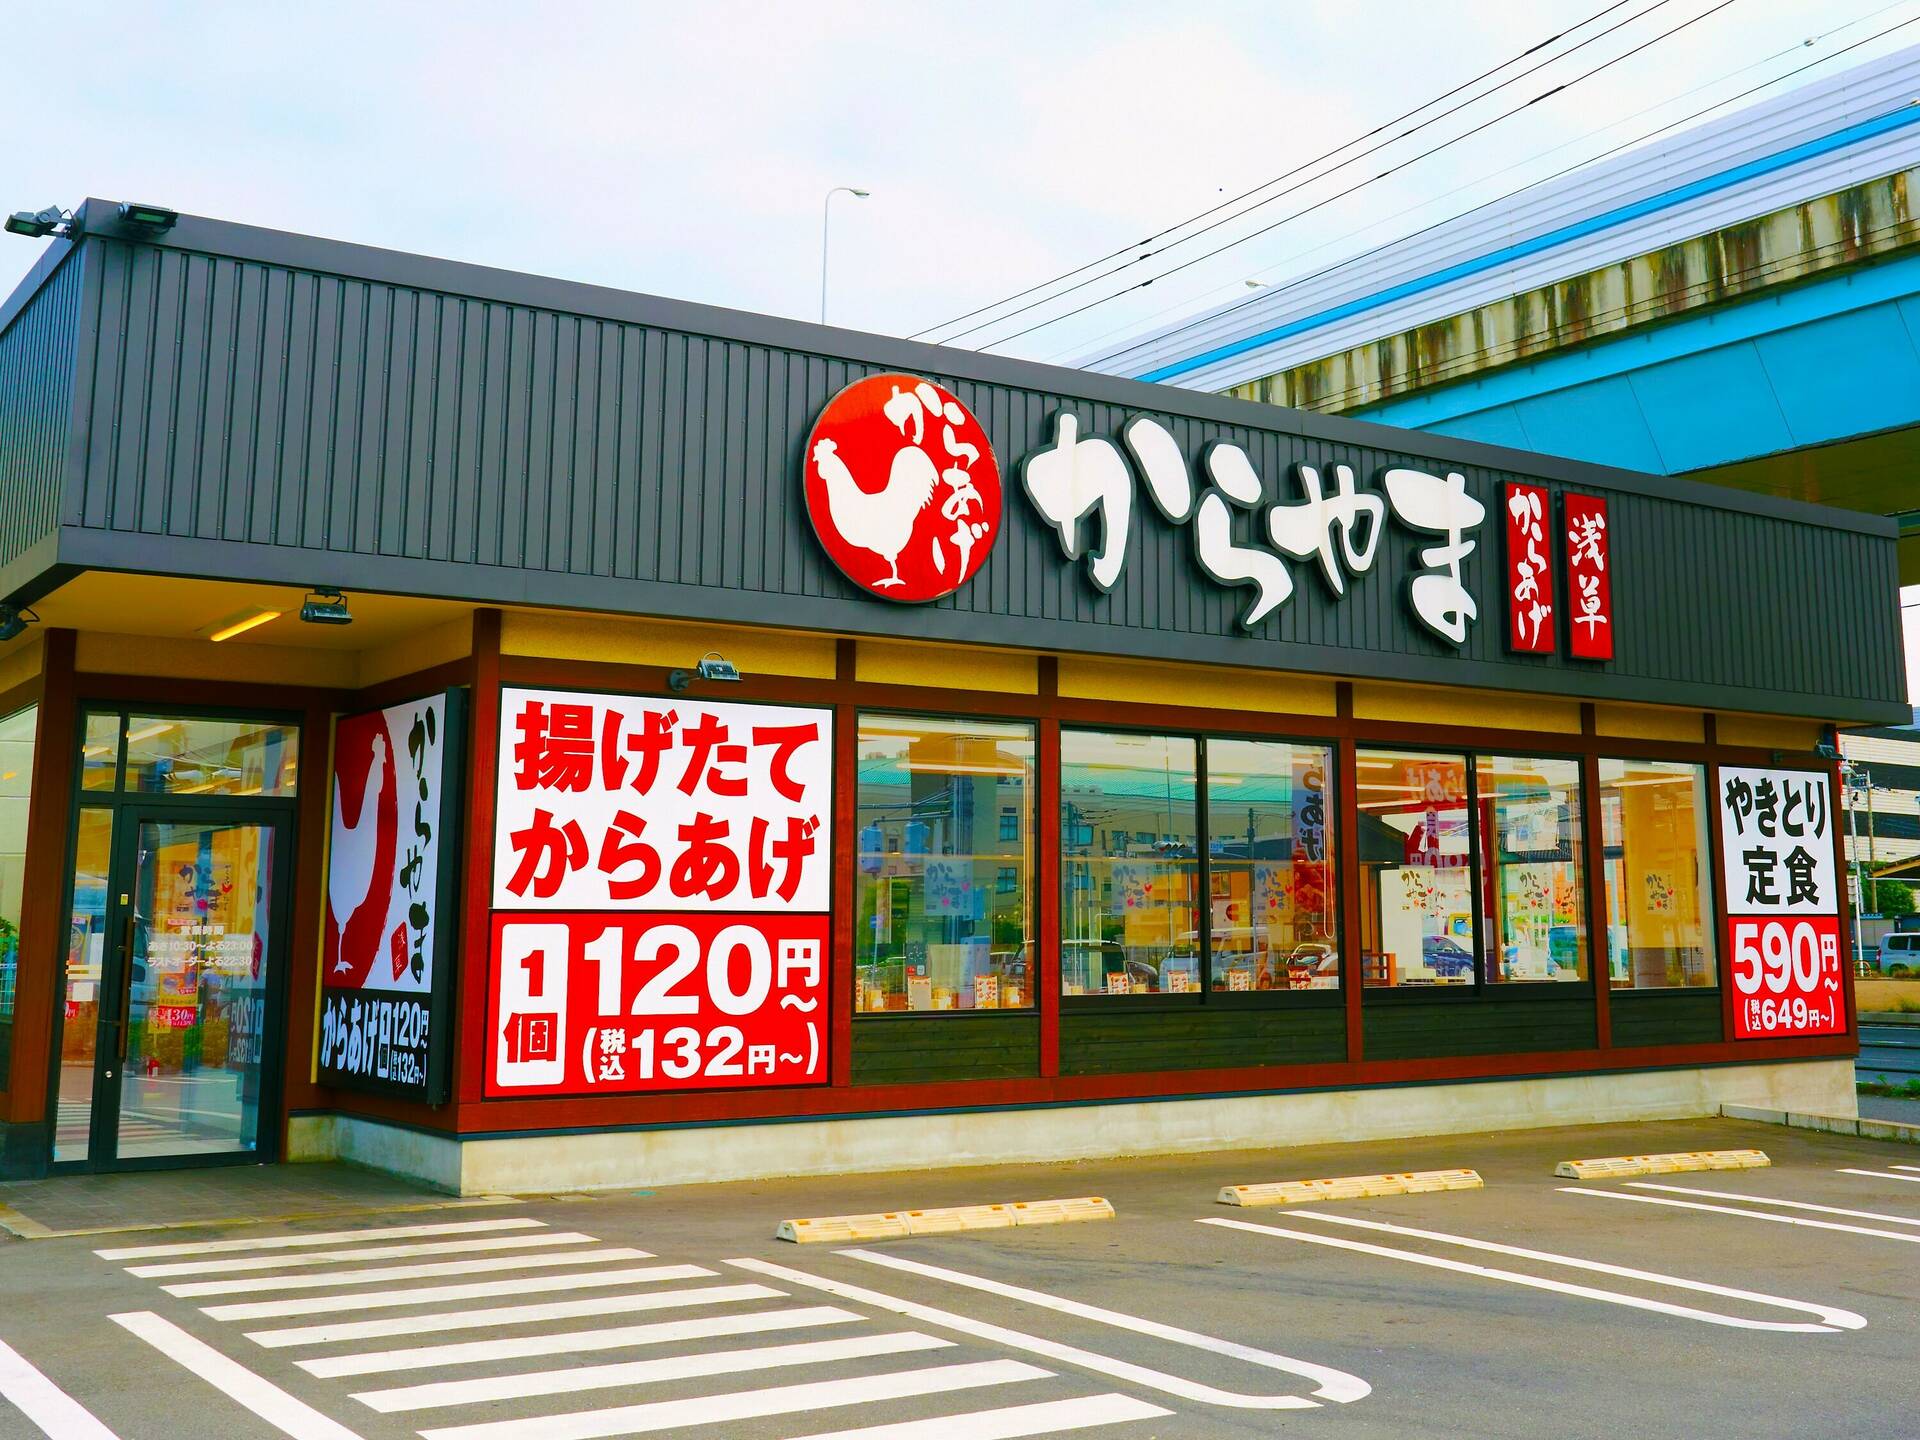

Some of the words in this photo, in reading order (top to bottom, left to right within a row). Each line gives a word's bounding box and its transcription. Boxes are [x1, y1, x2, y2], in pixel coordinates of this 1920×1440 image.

[883, 382, 990, 585] からあげ
[1027, 413, 1487, 645] からやま
[1508, 487, 1551, 649] からあげ
[1568, 512, 1608, 641] 浅草
[514, 700, 820, 803] 揚げたて
[1725, 775, 1826, 840] やきとり
[400, 705, 436, 985] からやま
[505, 808, 821, 903] からあげ
[1742, 845, 1820, 906] 定食
[321, 995, 380, 1078] からあげ
